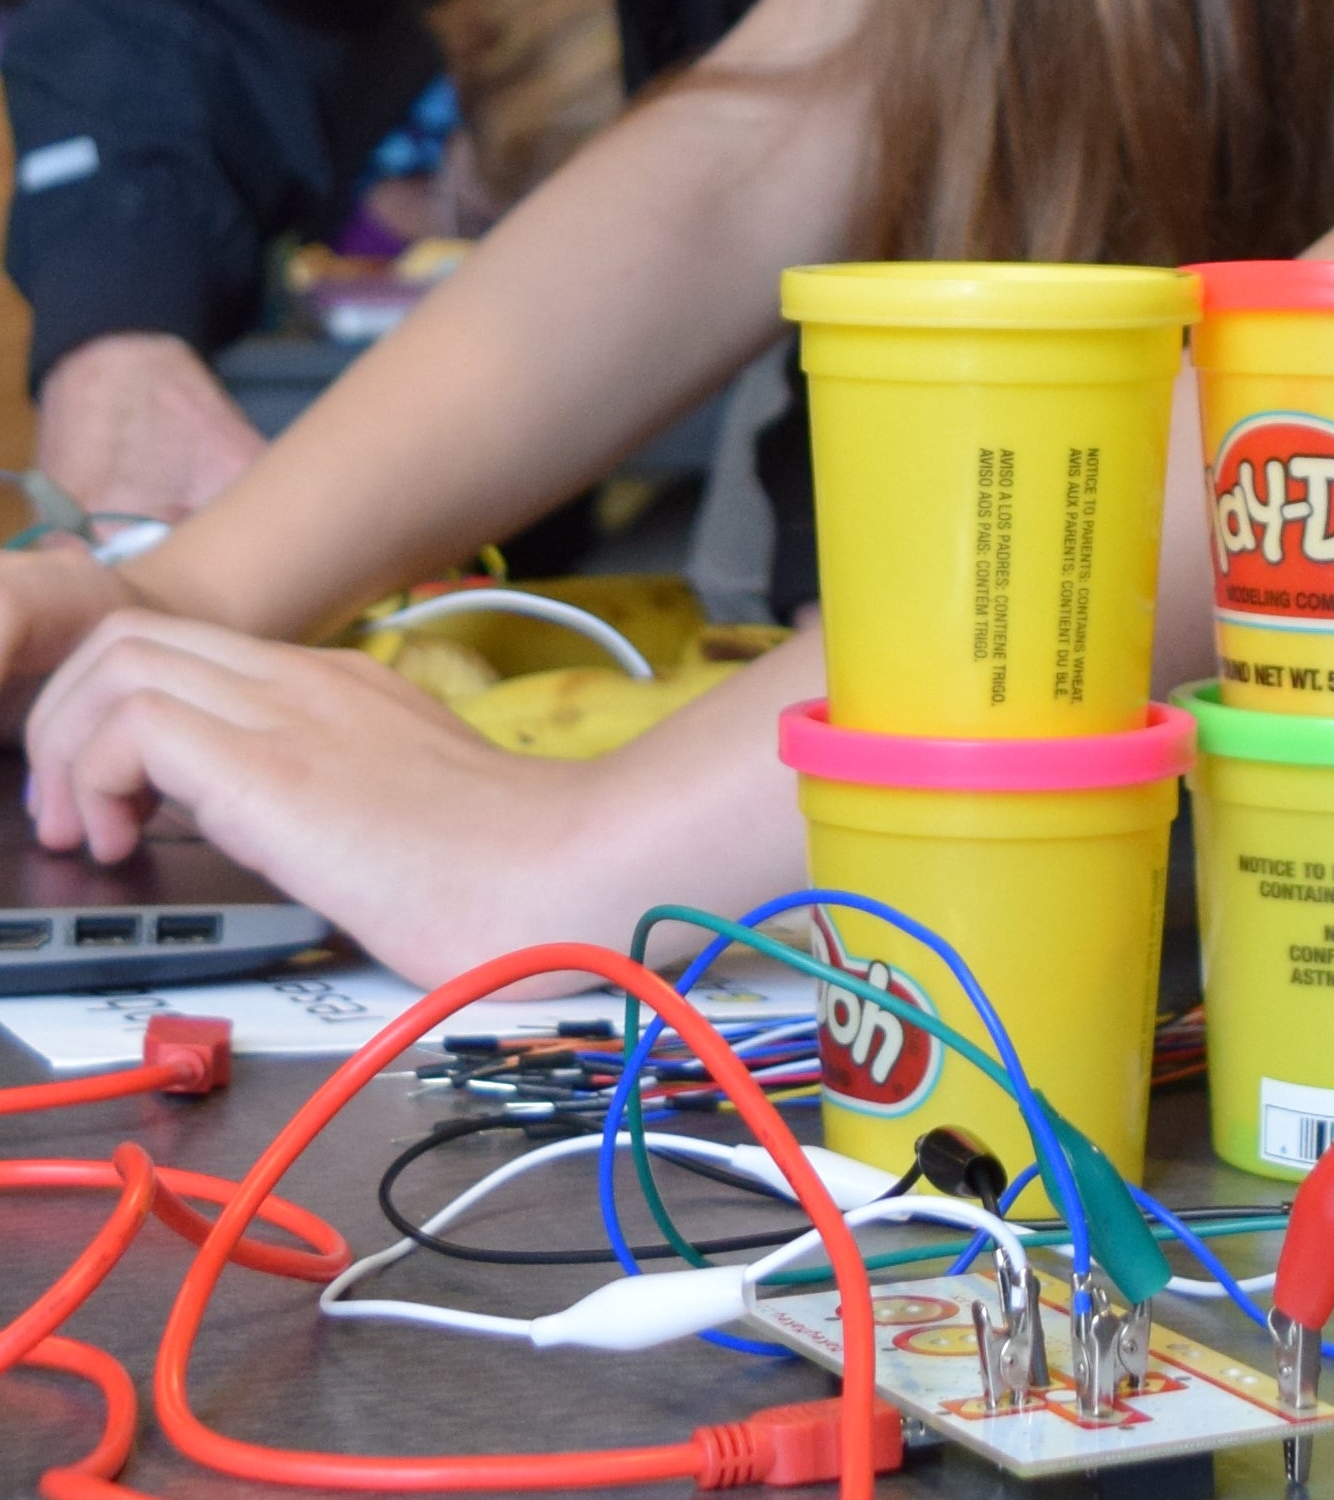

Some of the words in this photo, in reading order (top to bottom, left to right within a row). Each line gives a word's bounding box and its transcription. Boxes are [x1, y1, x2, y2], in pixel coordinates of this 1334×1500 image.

[978, 447, 994, 487] AVISO
[999, 448, 1015, 487] AVISO
[1067, 447, 1083, 478] AVIS
[1083, 447, 1100, 495] NOTICE
[977, 491, 993, 518] AOS
[999, 491, 1013, 501] A
[1065, 481, 1080, 507] AUX
[1083, 499, 1097, 516] TO
[997, 504, 1012, 530] LOS
[994, 534, 1011, 590] PADRES:
[1077, 520, 1096, 583] PARENTS:
[1057, 580, 1074, 645] CONTIENT
[1225, 584, 1292, 609] MODELING
[992, 595, 1009, 660] CONTIENE
[1073, 587, 1090, 653] CONTAINS
[973, 620, 989, 663] TRIGO.
[1055, 649, 1070, 667] DU
[990, 663, 1007, 707] TRIGO.
[1069, 656, 1085, 705] WHEAT.
[1253, 664, 1284, 688] NET
[1290, 667, 1323, 691] WT.
[1238, 854, 1296, 877] NOTICE
[1303, 861, 1325, 881] TO
